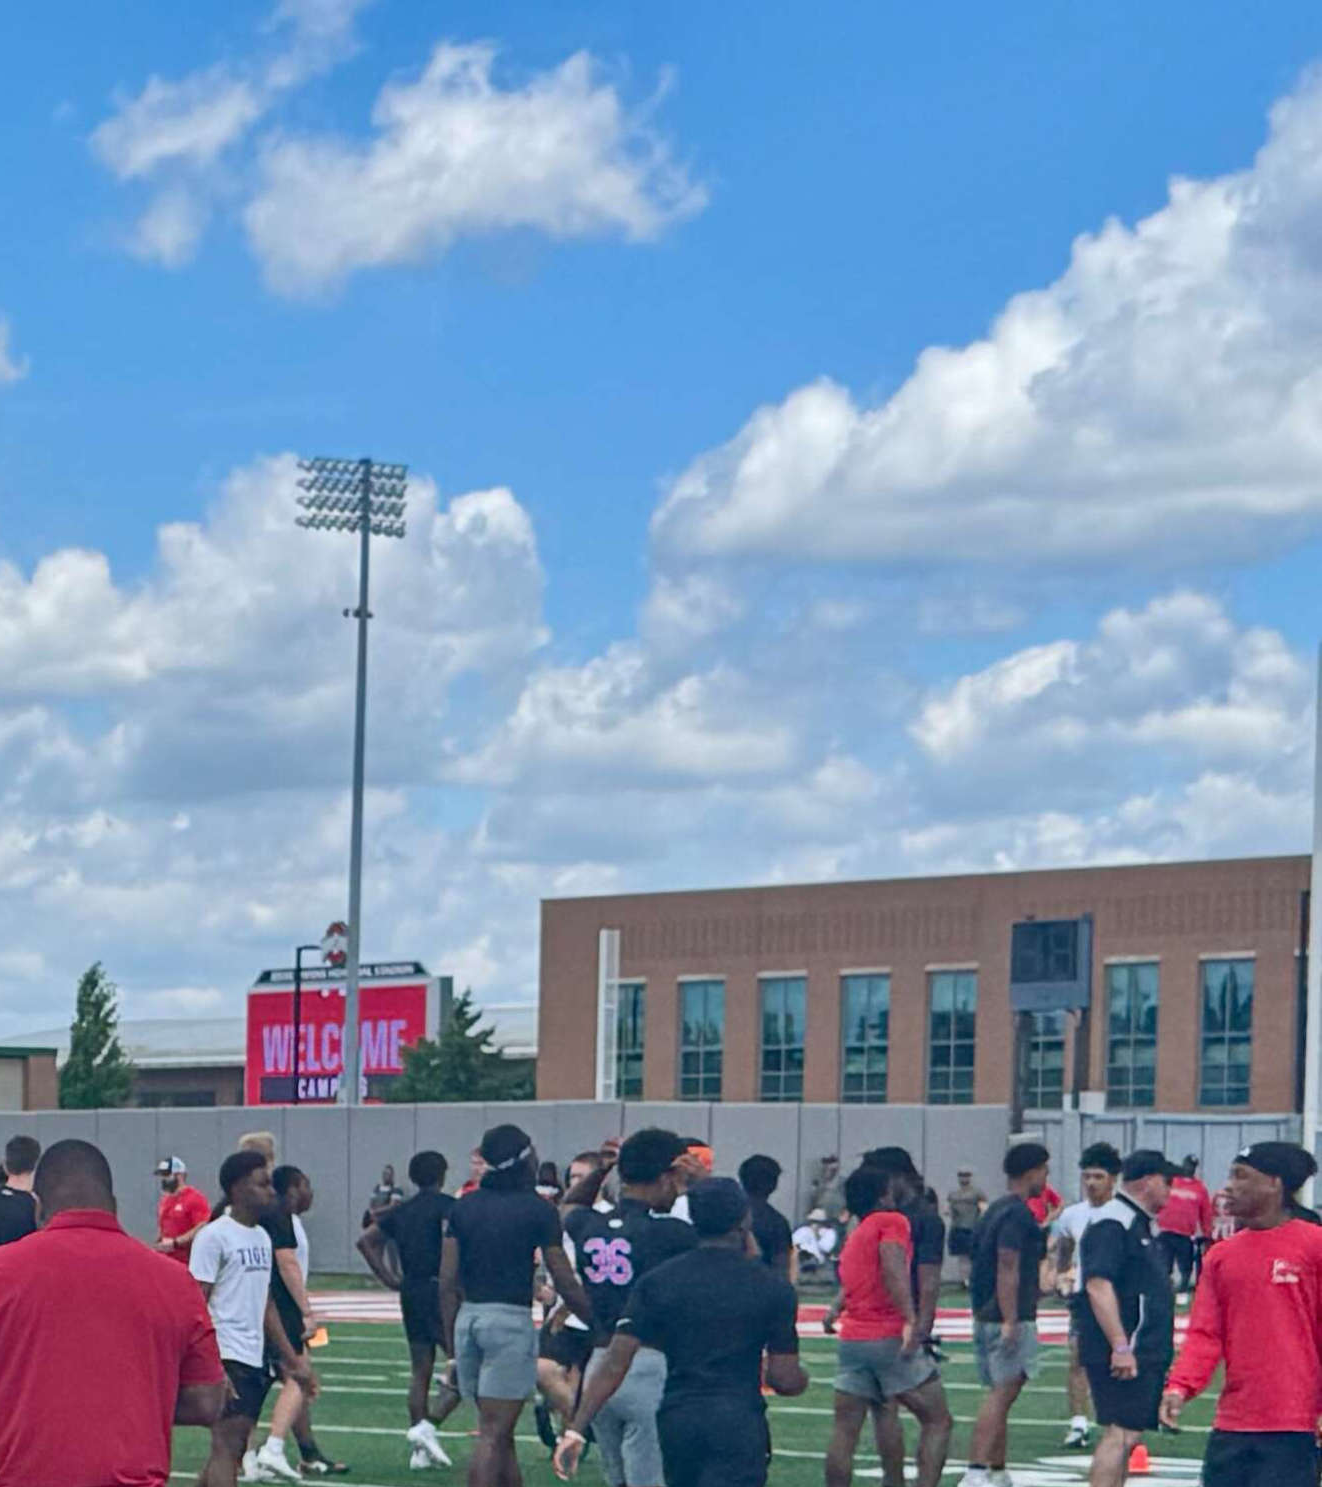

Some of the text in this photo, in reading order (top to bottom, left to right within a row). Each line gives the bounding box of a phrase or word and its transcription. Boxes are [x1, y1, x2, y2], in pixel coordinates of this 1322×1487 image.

[262, 1019, 407, 1074] WELCME
[298, 1076, 368, 1098] CAMPS
[583, 1237, 634, 1286] 36
